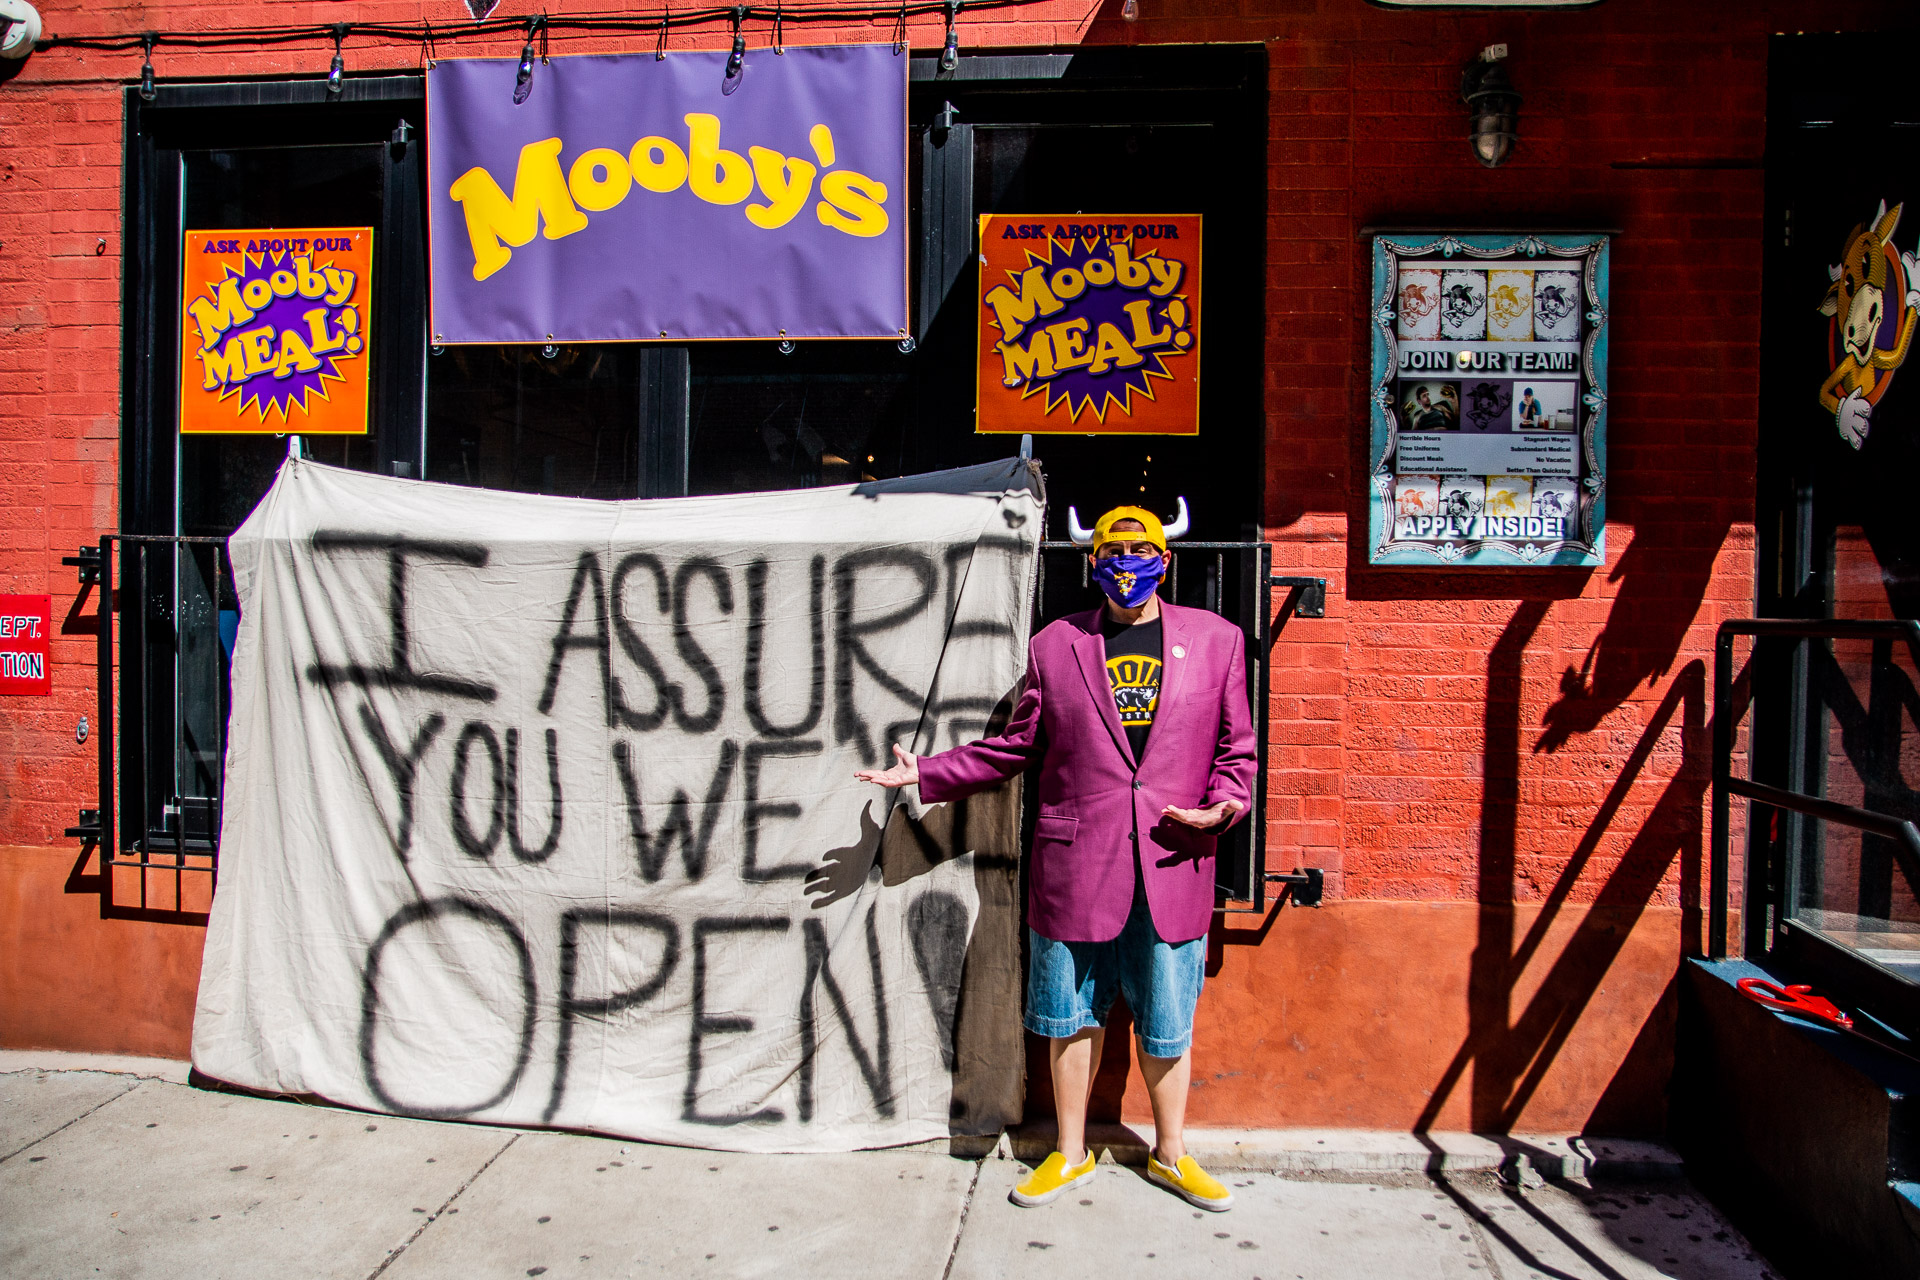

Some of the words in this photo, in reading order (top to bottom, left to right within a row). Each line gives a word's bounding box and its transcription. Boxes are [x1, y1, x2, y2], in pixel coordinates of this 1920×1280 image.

[450, 113, 889, 281] Mooby's
[1002, 224, 1046, 239] ASK
[1053, 224, 1128, 239] ABOUT
[1132, 224, 1179, 239] OUR
[203, 239, 241, 253] ASK
[246, 238, 309, 253] ABOUT
[313, 238, 352, 251] OUR
[187, 255, 356, 350] Mooby
[984, 241, 1184, 345] Mooby
[198, 305, 363, 391] MEAL!
[996, 299, 1194, 387] MEAL!
[1400, 351, 1448, 369] JOIN
[1455, 350, 1501, 369] OUR
[1507, 351, 1573, 369] TEAM!
[1401, 516, 1474, 535] APPLY
[1481, 516, 1565, 537] INSIDE!
[307, 528, 499, 703] I
[538, 532, 1035, 745] ASSURE
[358, 701, 564, 865] YOU
[358, 888, 970, 1125] OPEN!
